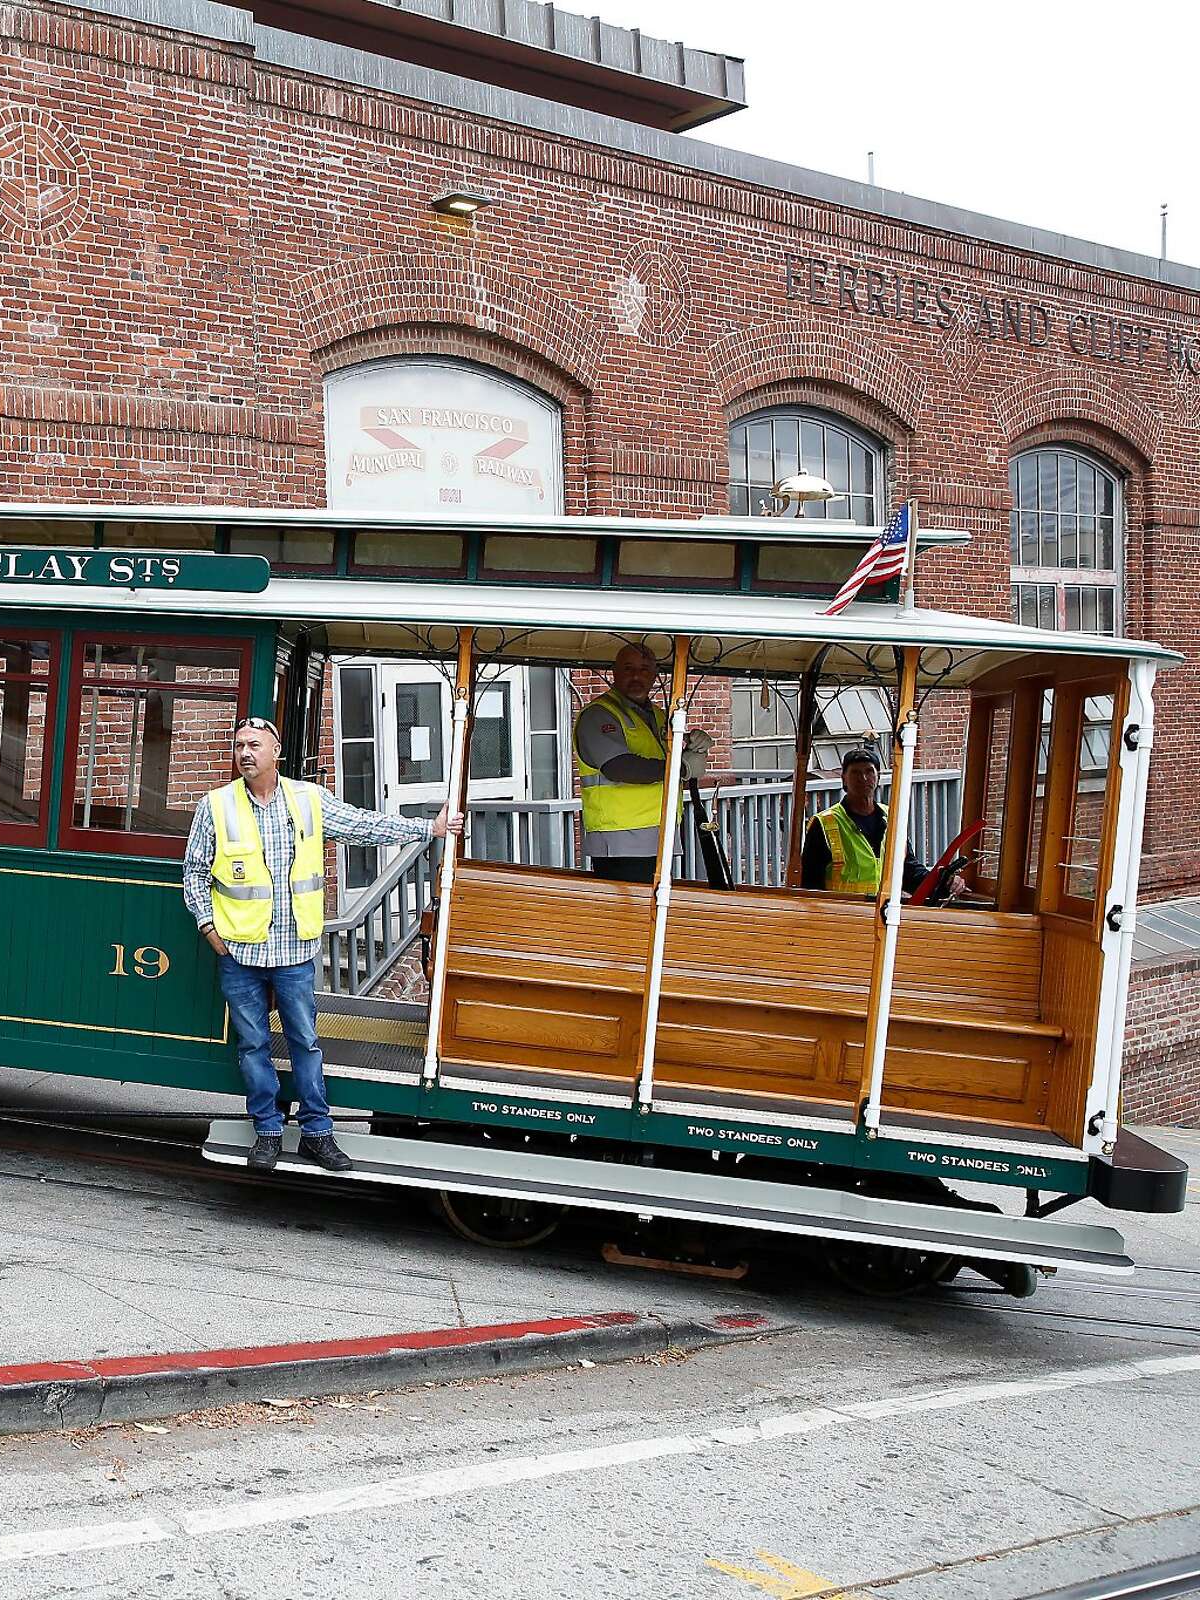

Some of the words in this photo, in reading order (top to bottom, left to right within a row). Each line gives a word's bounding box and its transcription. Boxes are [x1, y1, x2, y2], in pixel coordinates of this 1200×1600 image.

[784, 253, 956, 330] FERRIES
[974, 292, 1051, 347] AND
[1069, 313, 1151, 366] CLIFF
[376, 407, 412, 426] SAN
[421, 408, 513, 434] FRANCISCO
[351, 452, 425, 475] MUNICIPAL
[476, 458, 535, 486] RAILWAY
[107, 943, 171, 979] 19
[471, 1101, 498, 1113] TWO
[501, 1105, 562, 1120] STANDEES
[566, 1112, 596, 1124] ONLY
[687, 1125, 715, 1137] TWO
[718, 1129, 783, 1145] STANDEES
[786, 1137, 819, 1150] ONLY
[907, 1151, 937, 1164] TWO
[941, 1155, 1010, 1172] STANDEES
